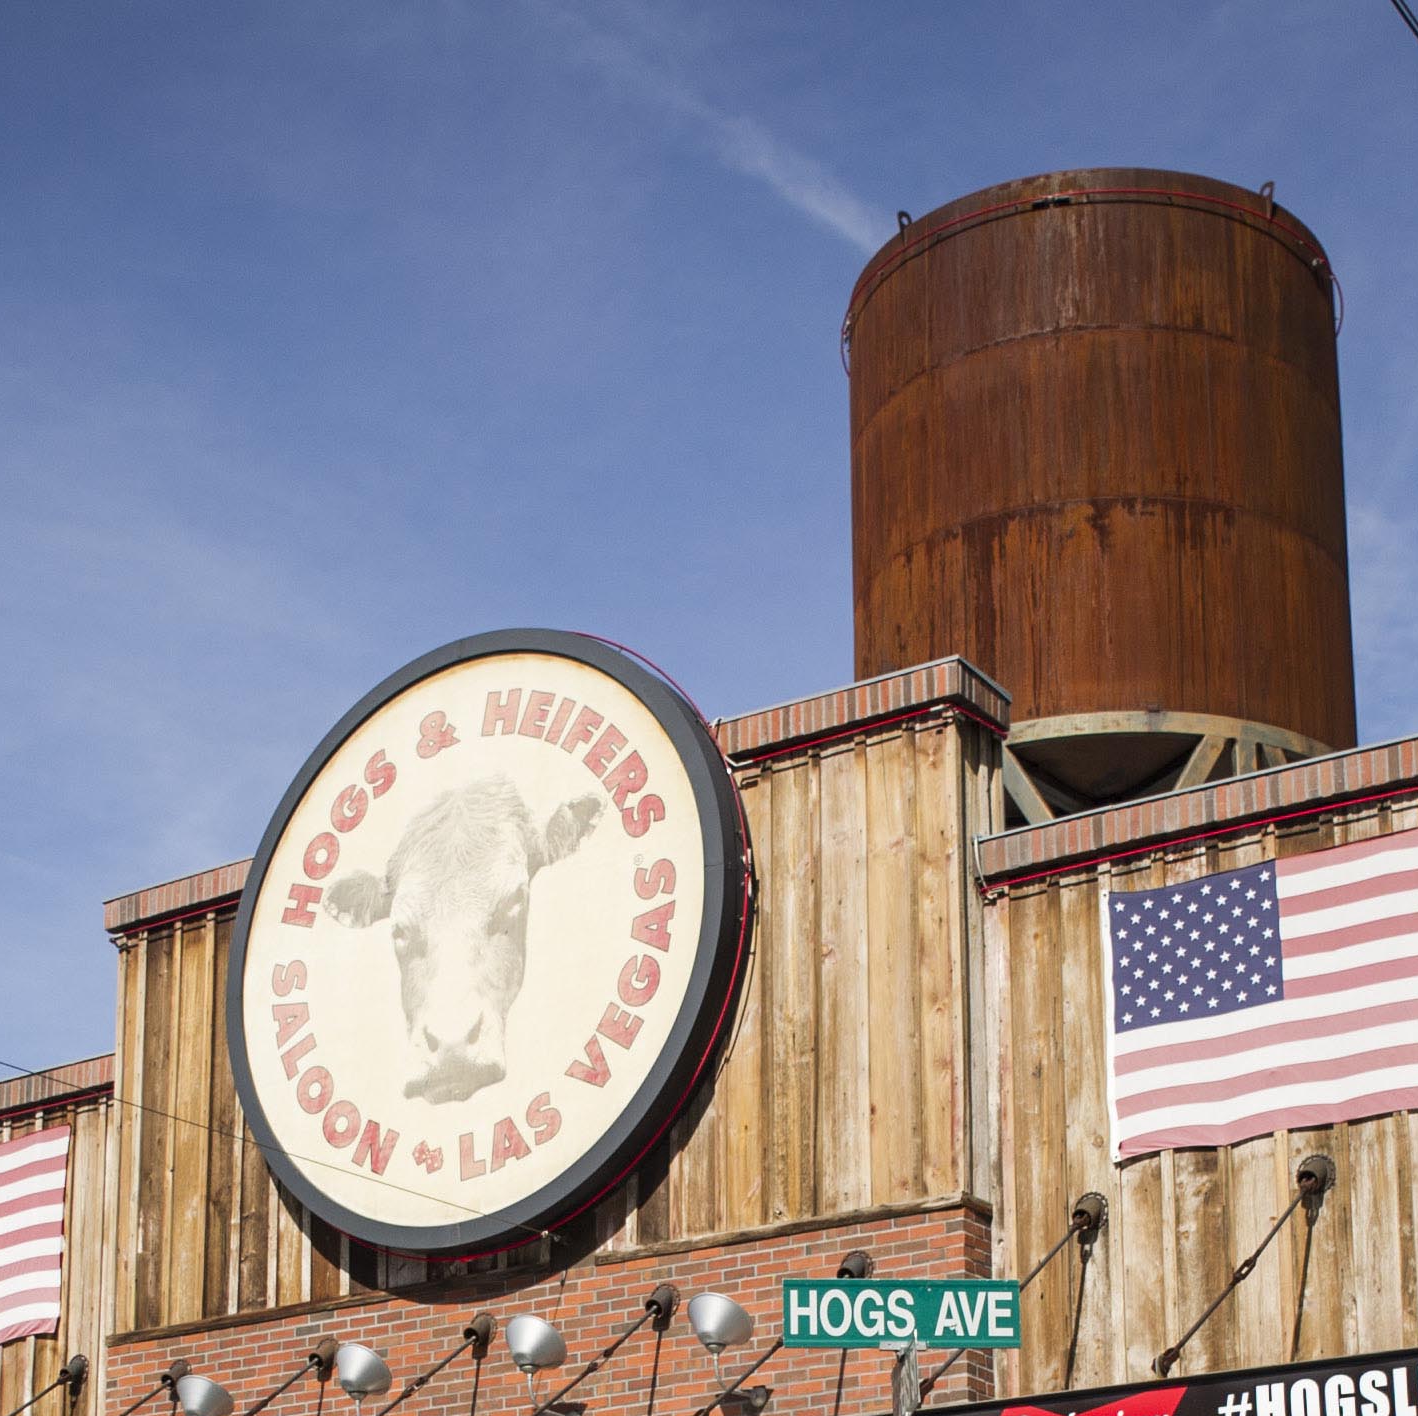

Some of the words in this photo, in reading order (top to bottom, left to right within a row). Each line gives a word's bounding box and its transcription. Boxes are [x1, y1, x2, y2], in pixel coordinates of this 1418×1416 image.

[281, 748, 397, 929] HOGS
[415, 709, 462, 760] &
[480, 687, 666, 839] HEIFERS
[271, 959, 400, 1176] SALOON
[458, 1091, 563, 1182] LAS
[564, 857, 677, 1089] VEGAS
[788, 1289, 917, 1338] HOGS
[933, 1290, 1015, 1338] AVE
